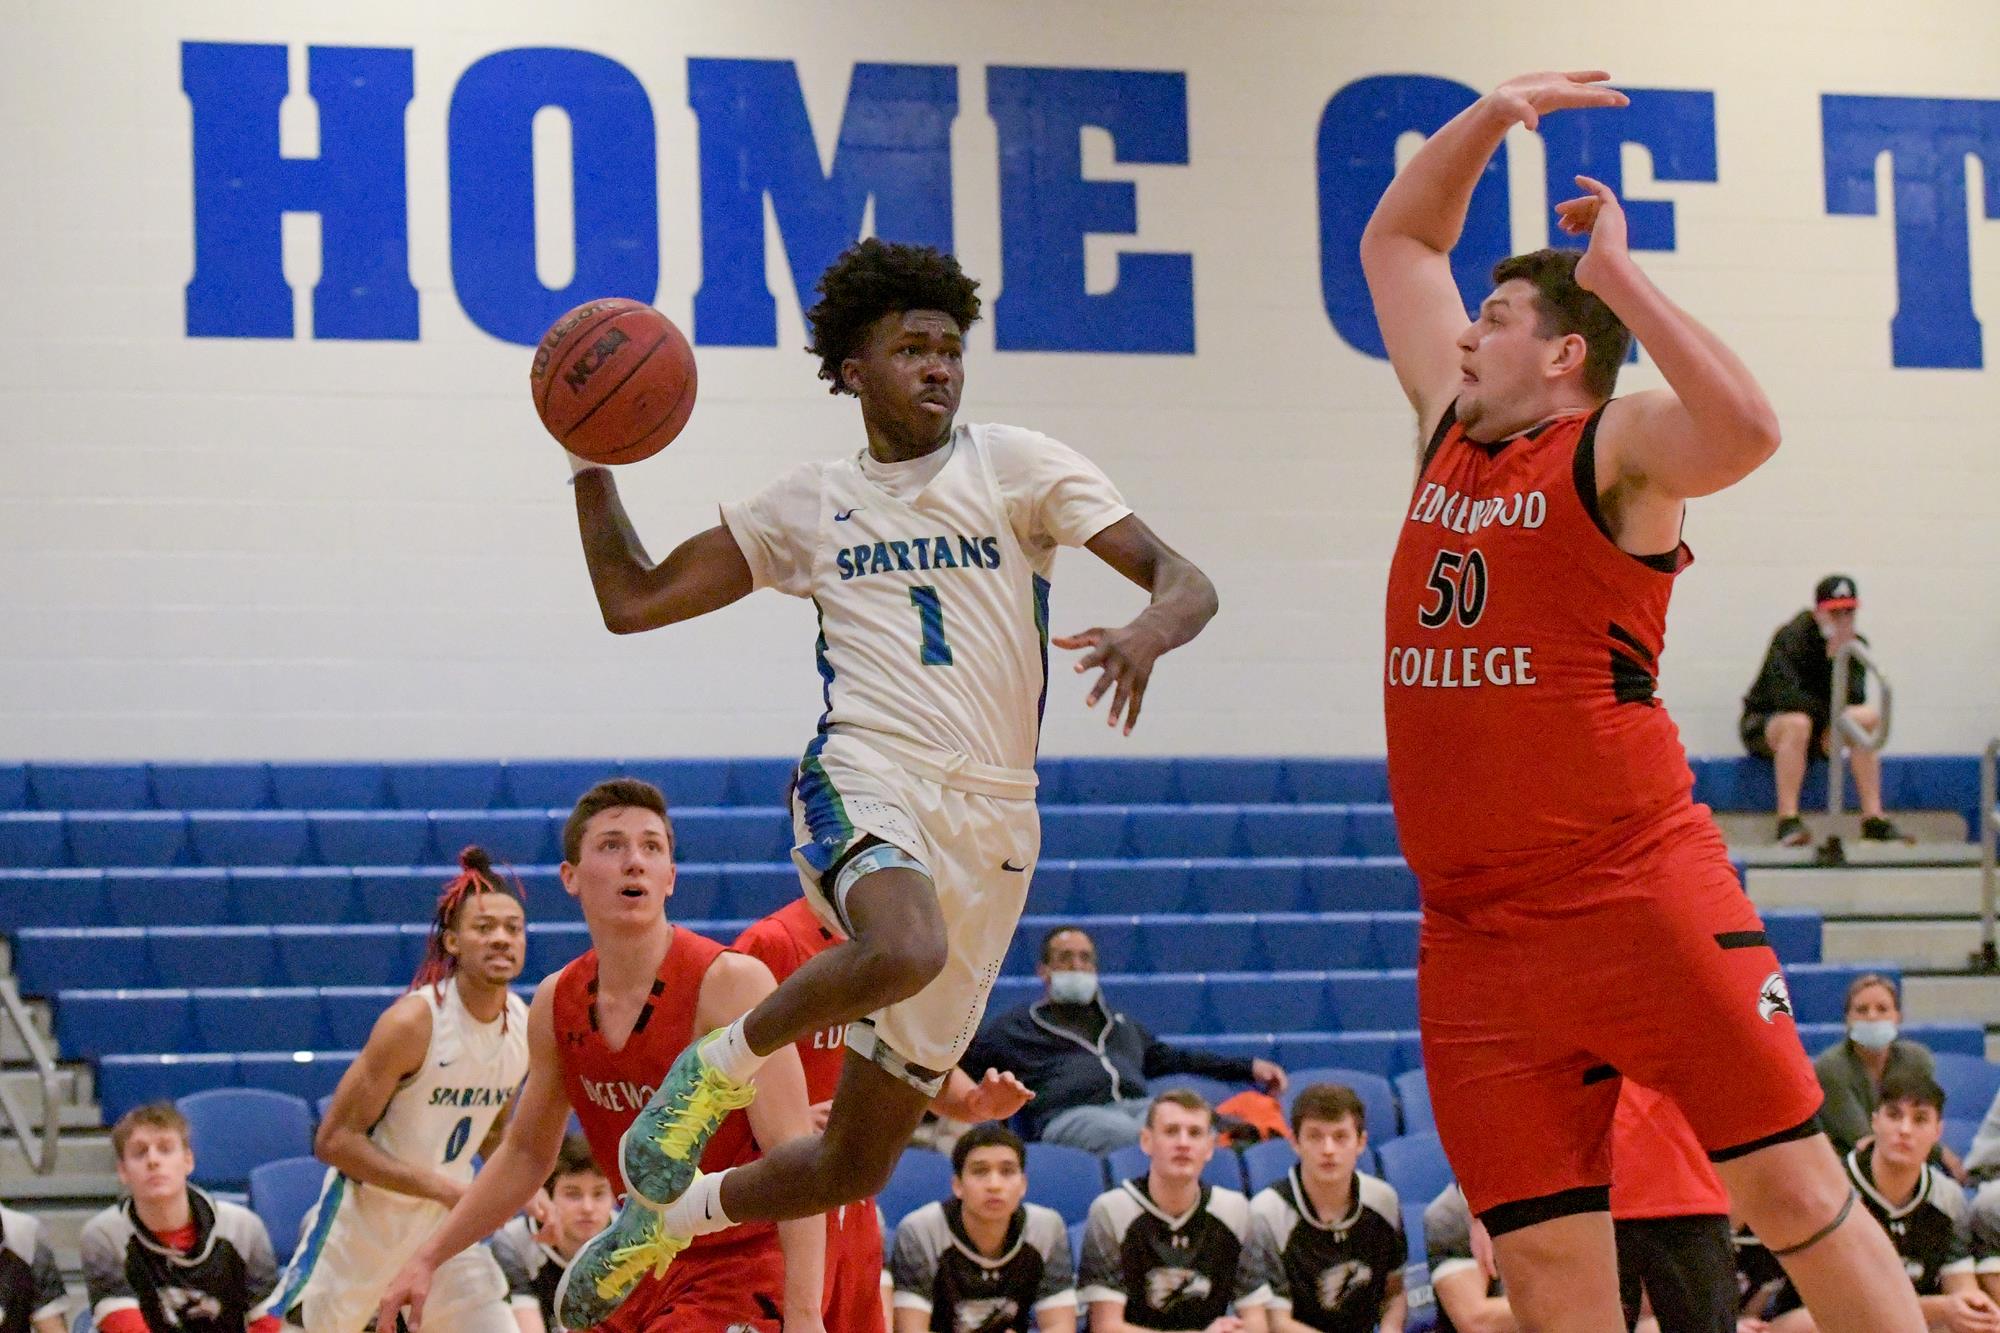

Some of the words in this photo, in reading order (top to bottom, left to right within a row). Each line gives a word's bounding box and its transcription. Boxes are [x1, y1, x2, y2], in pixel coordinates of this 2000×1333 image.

[180, 40, 1196, 355] HOME
[1316, 73, 1719, 363] OF
[563, 326, 632, 395] NCAA
[836, 535, 1001, 580] SPARTANS
[1418, 549, 1488, 628] 50
[909, 585, 953, 666] 1
[1389, 646, 1537, 687] COLLEGE
[442, 1116, 472, 1164] 0
